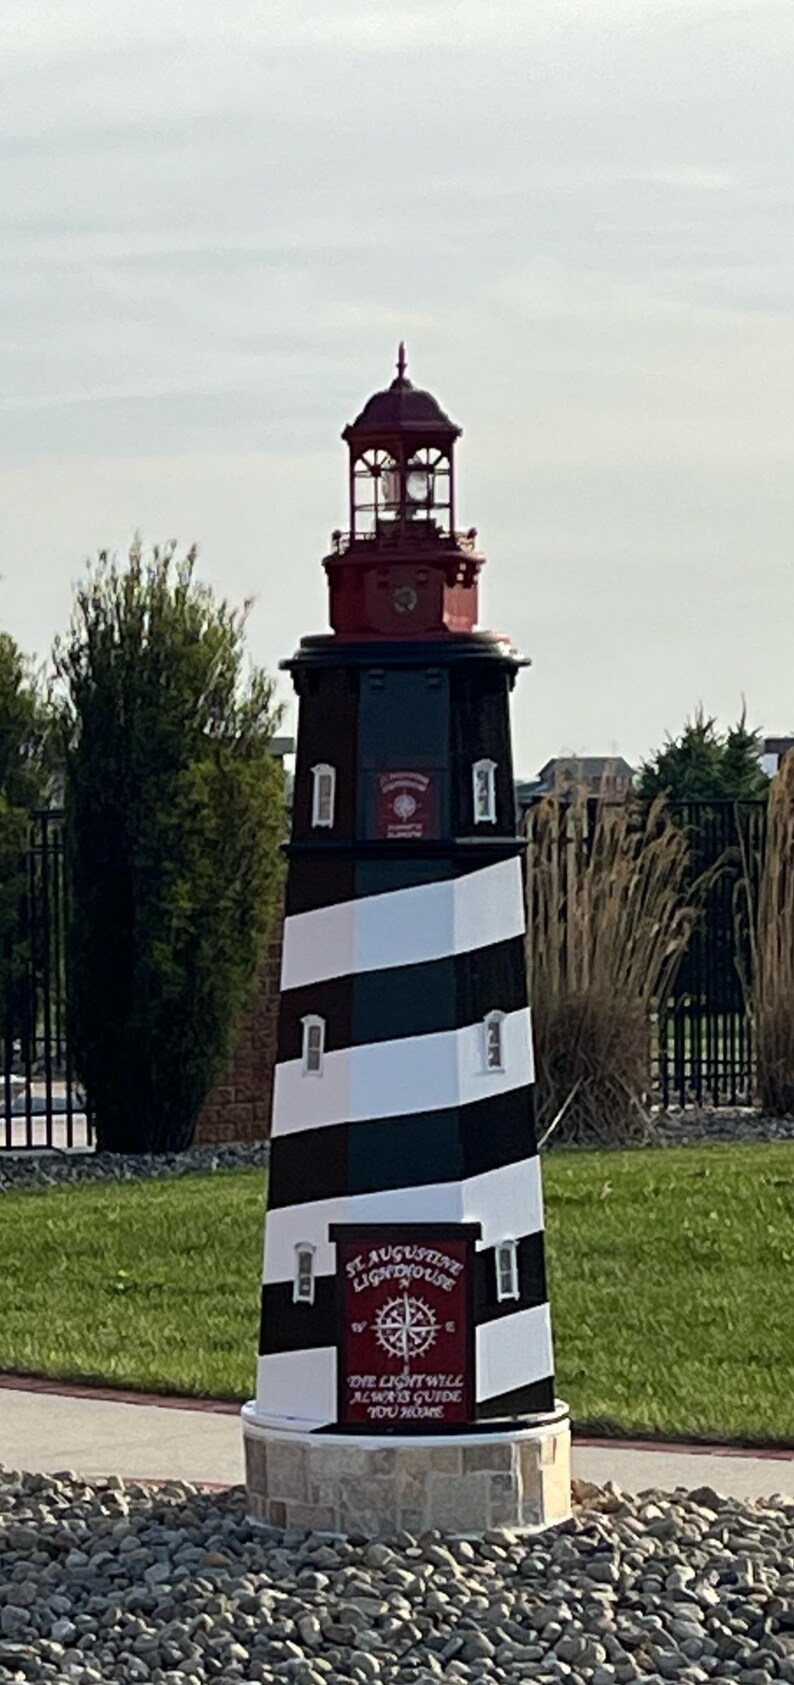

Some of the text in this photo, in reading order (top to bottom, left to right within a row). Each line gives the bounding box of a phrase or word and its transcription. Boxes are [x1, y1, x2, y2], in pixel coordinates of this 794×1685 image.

[353, 1263, 457, 1293] LIGHTHOUSE
[347, 1374, 464, 1391] THE LIGHT WILL
[349, 1390, 462, 1406] ALWAYS GUIDE
[367, 1405, 444, 1419] YOU HOME
